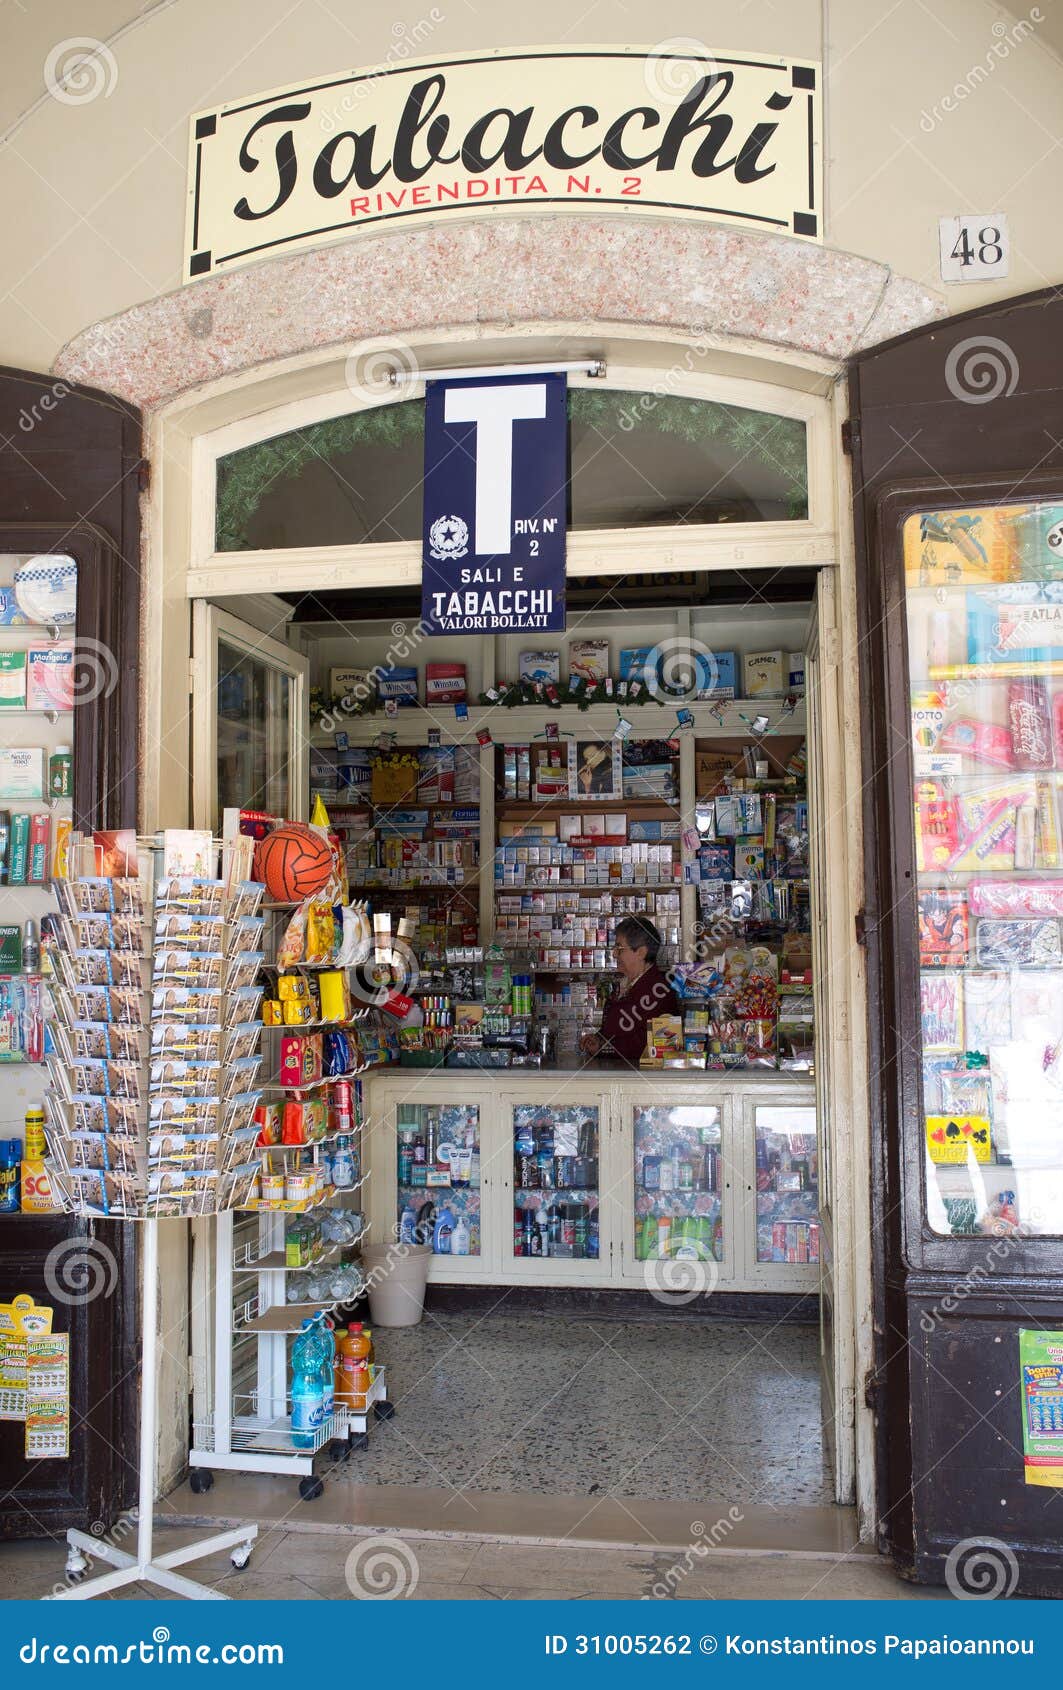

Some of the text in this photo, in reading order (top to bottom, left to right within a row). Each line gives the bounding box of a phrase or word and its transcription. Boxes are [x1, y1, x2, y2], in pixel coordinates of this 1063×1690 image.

[234, 72, 792, 220] Tabacchi
[350, 175, 641, 217] RIVENDITA N. 2
[949, 227, 1003, 266] 48
[444, 383, 547, 556] T
[514, 518, 540, 535] RIV.
[529, 539, 539, 557] 2
[461, 567, 524, 584] SALI E
[432, 589, 553, 617] TABACCHI
[439, 614, 548, 630] VALORI BOLLATI
[34, 652, 69, 663] Marigold
[748, 656, 777, 667] CAMEL
[433, 680, 460, 689] Winston
[912, 711, 943, 720] IOTTO
[0, 1167, 16, 1184] aid
[521, 1156, 529, 1188] DENIM
